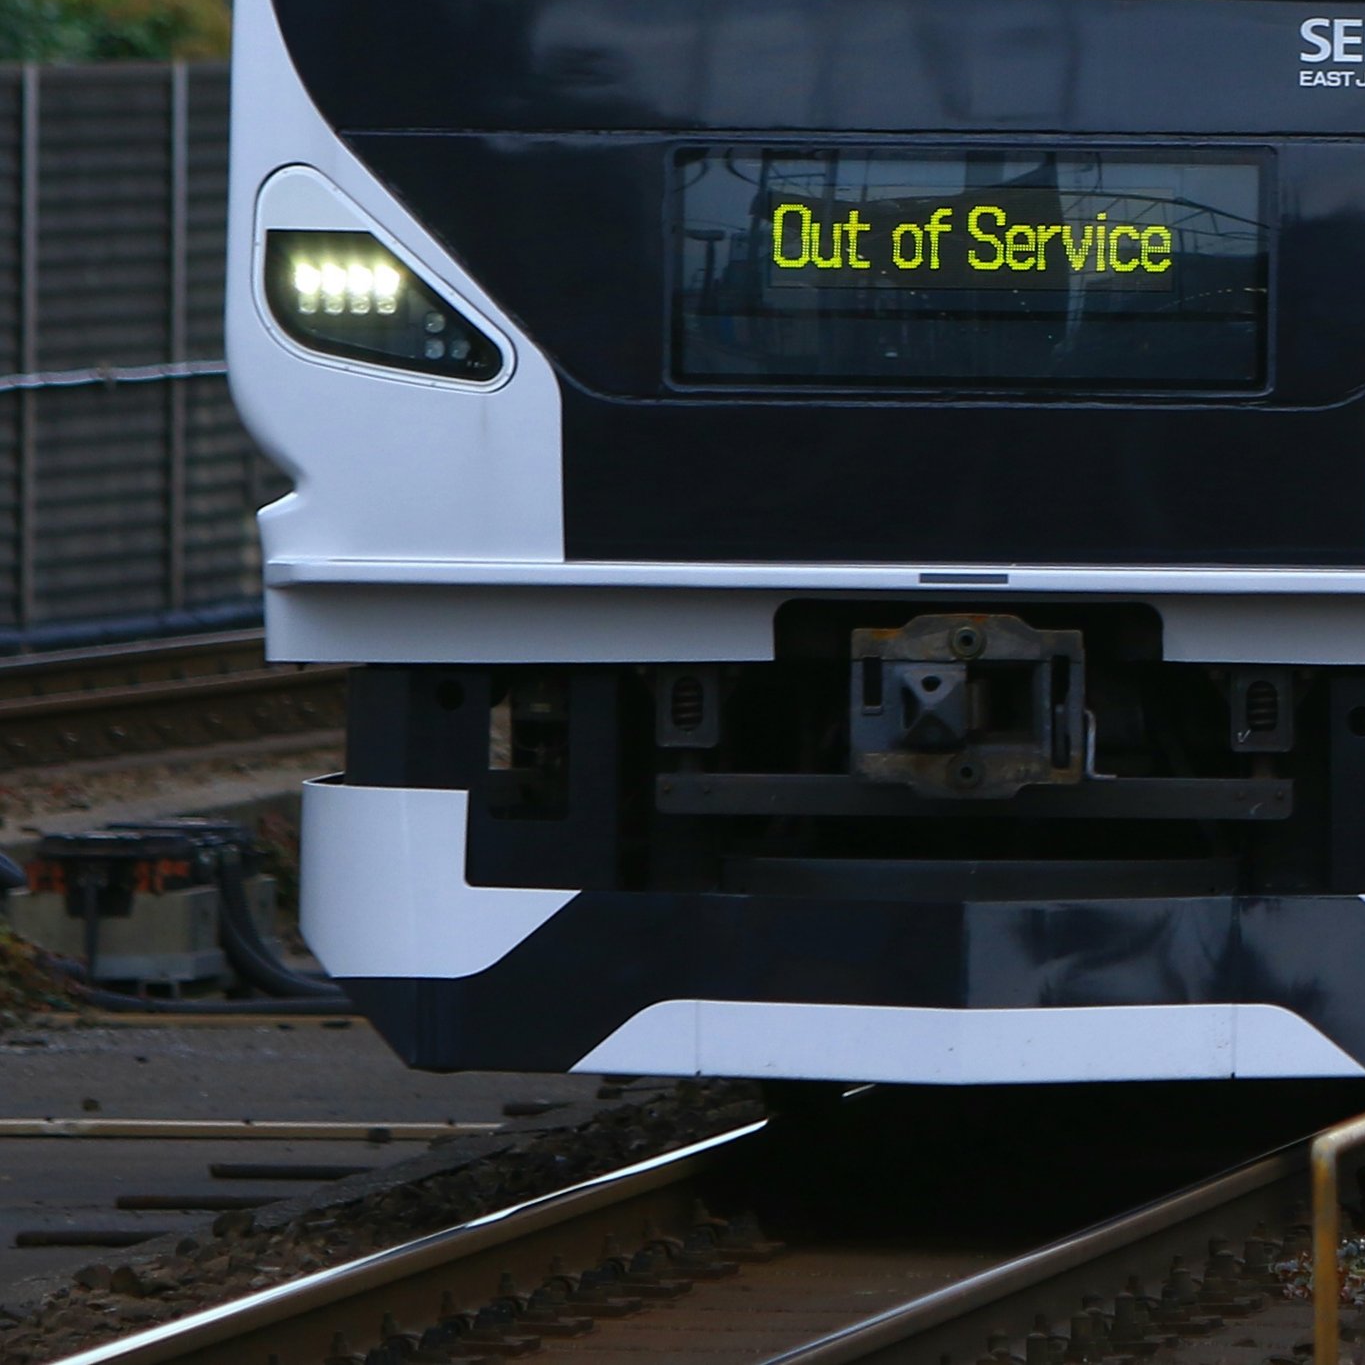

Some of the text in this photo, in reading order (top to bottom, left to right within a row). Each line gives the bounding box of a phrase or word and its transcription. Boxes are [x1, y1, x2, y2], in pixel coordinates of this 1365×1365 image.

[1300, 71, 1355, 87] EAST
[773, 204, 1172, 273] Out of Service
